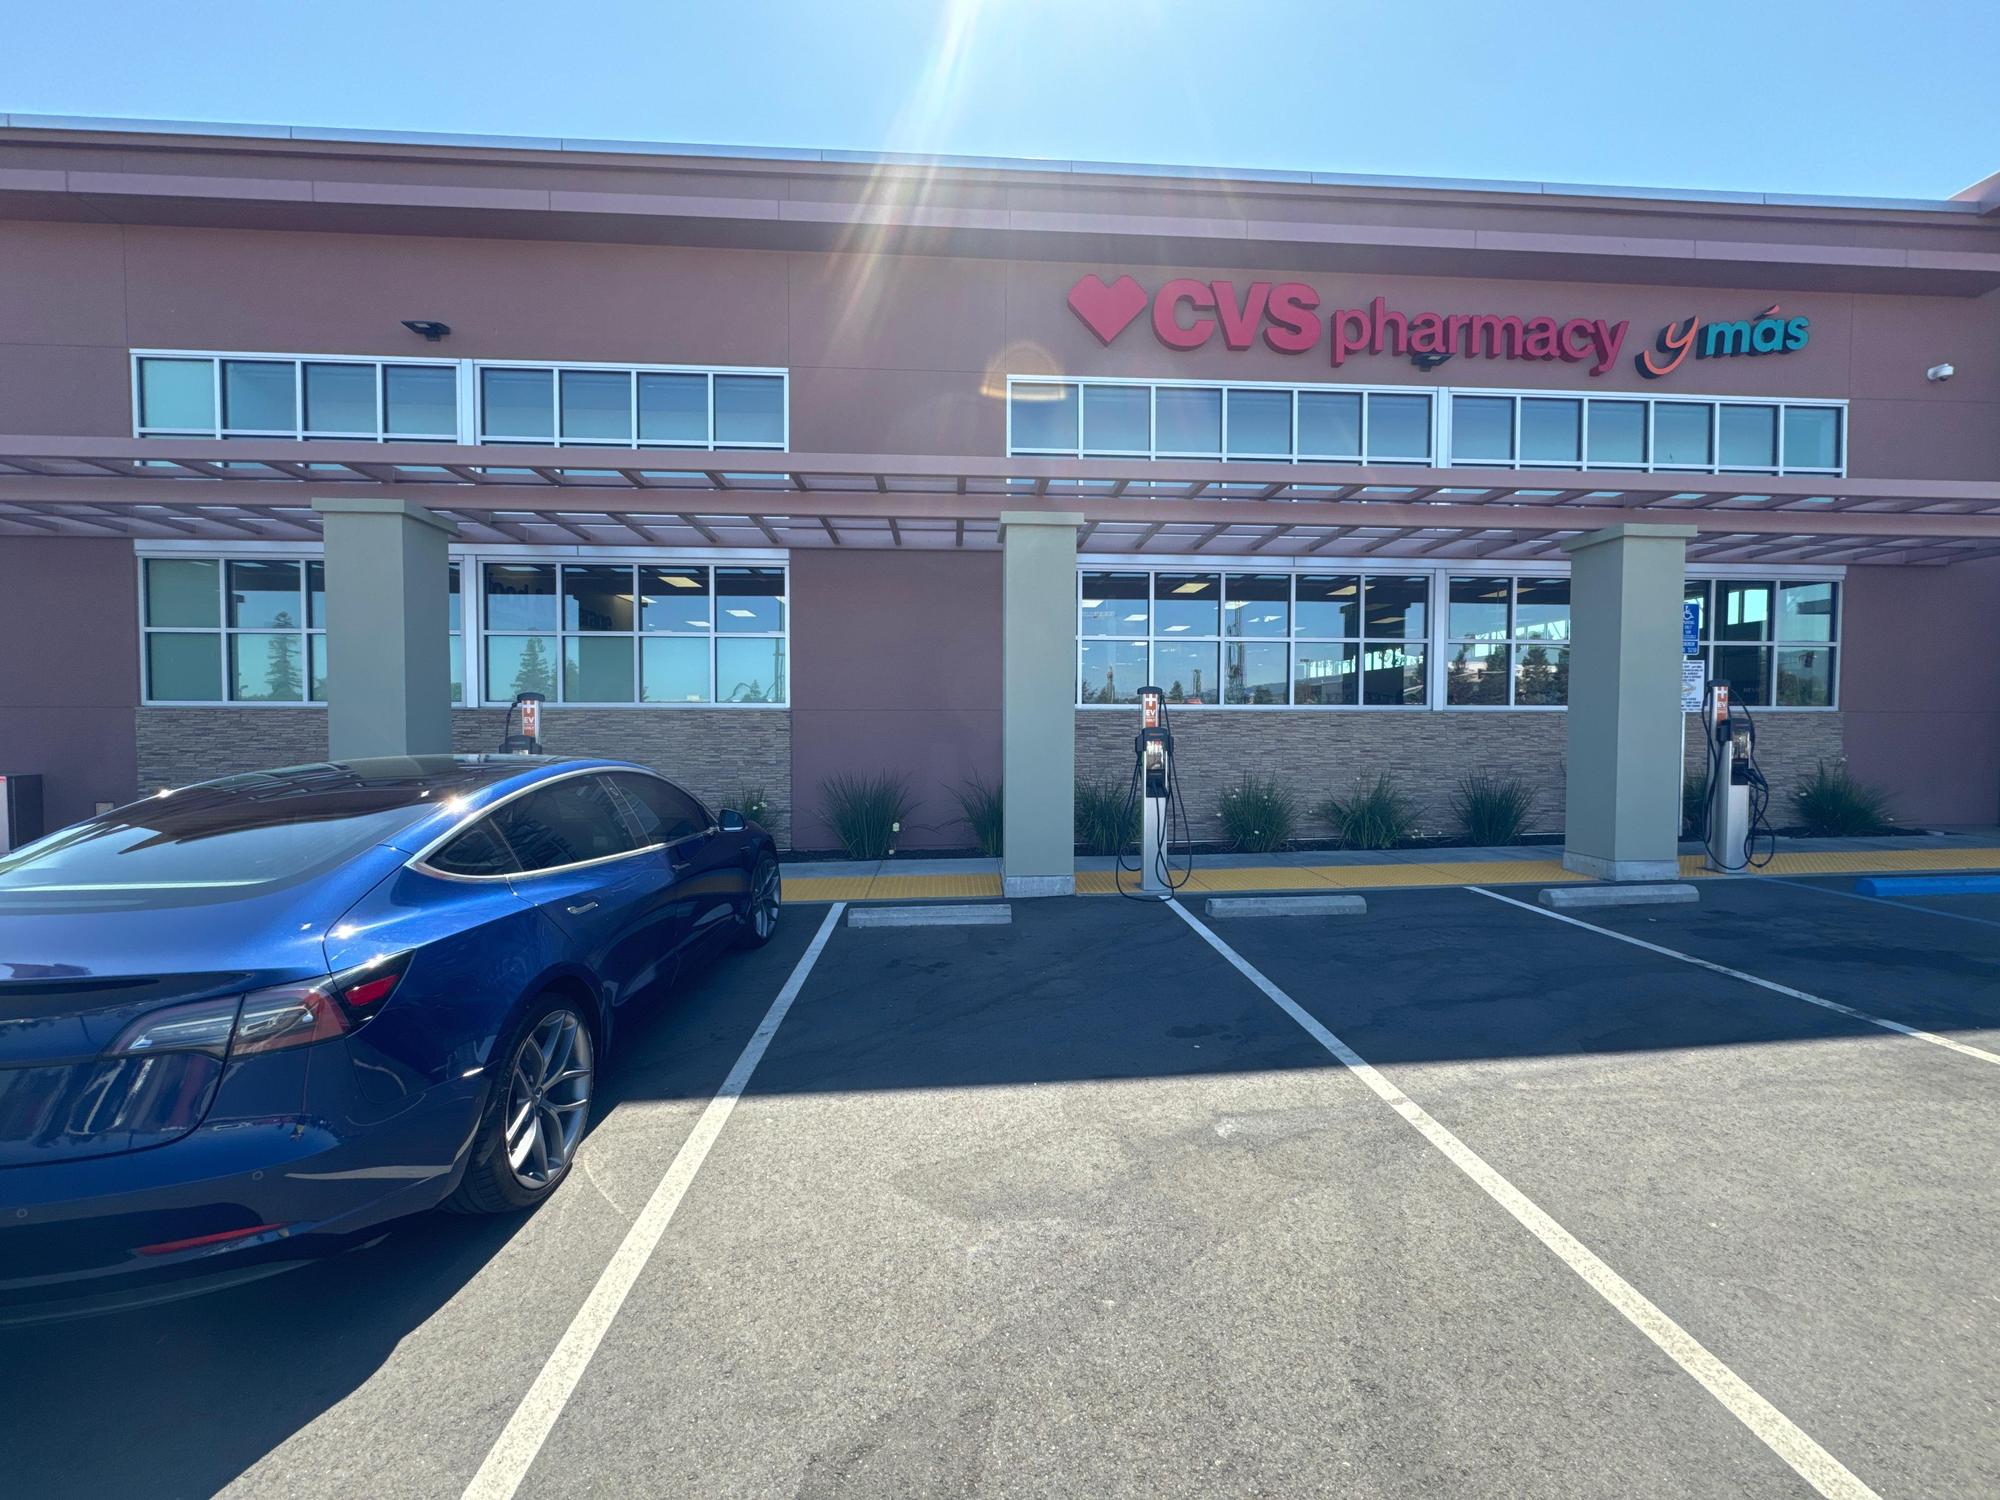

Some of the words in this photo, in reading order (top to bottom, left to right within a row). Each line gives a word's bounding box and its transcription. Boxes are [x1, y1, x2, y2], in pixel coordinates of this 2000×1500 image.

[1152, 278, 1321, 354] CVS
[1331, 297, 1629, 376] pharmacy
[1636, 316, 1699, 379] y
[1696, 304, 1809, 360] más
[524, 716, 535, 724] EV
